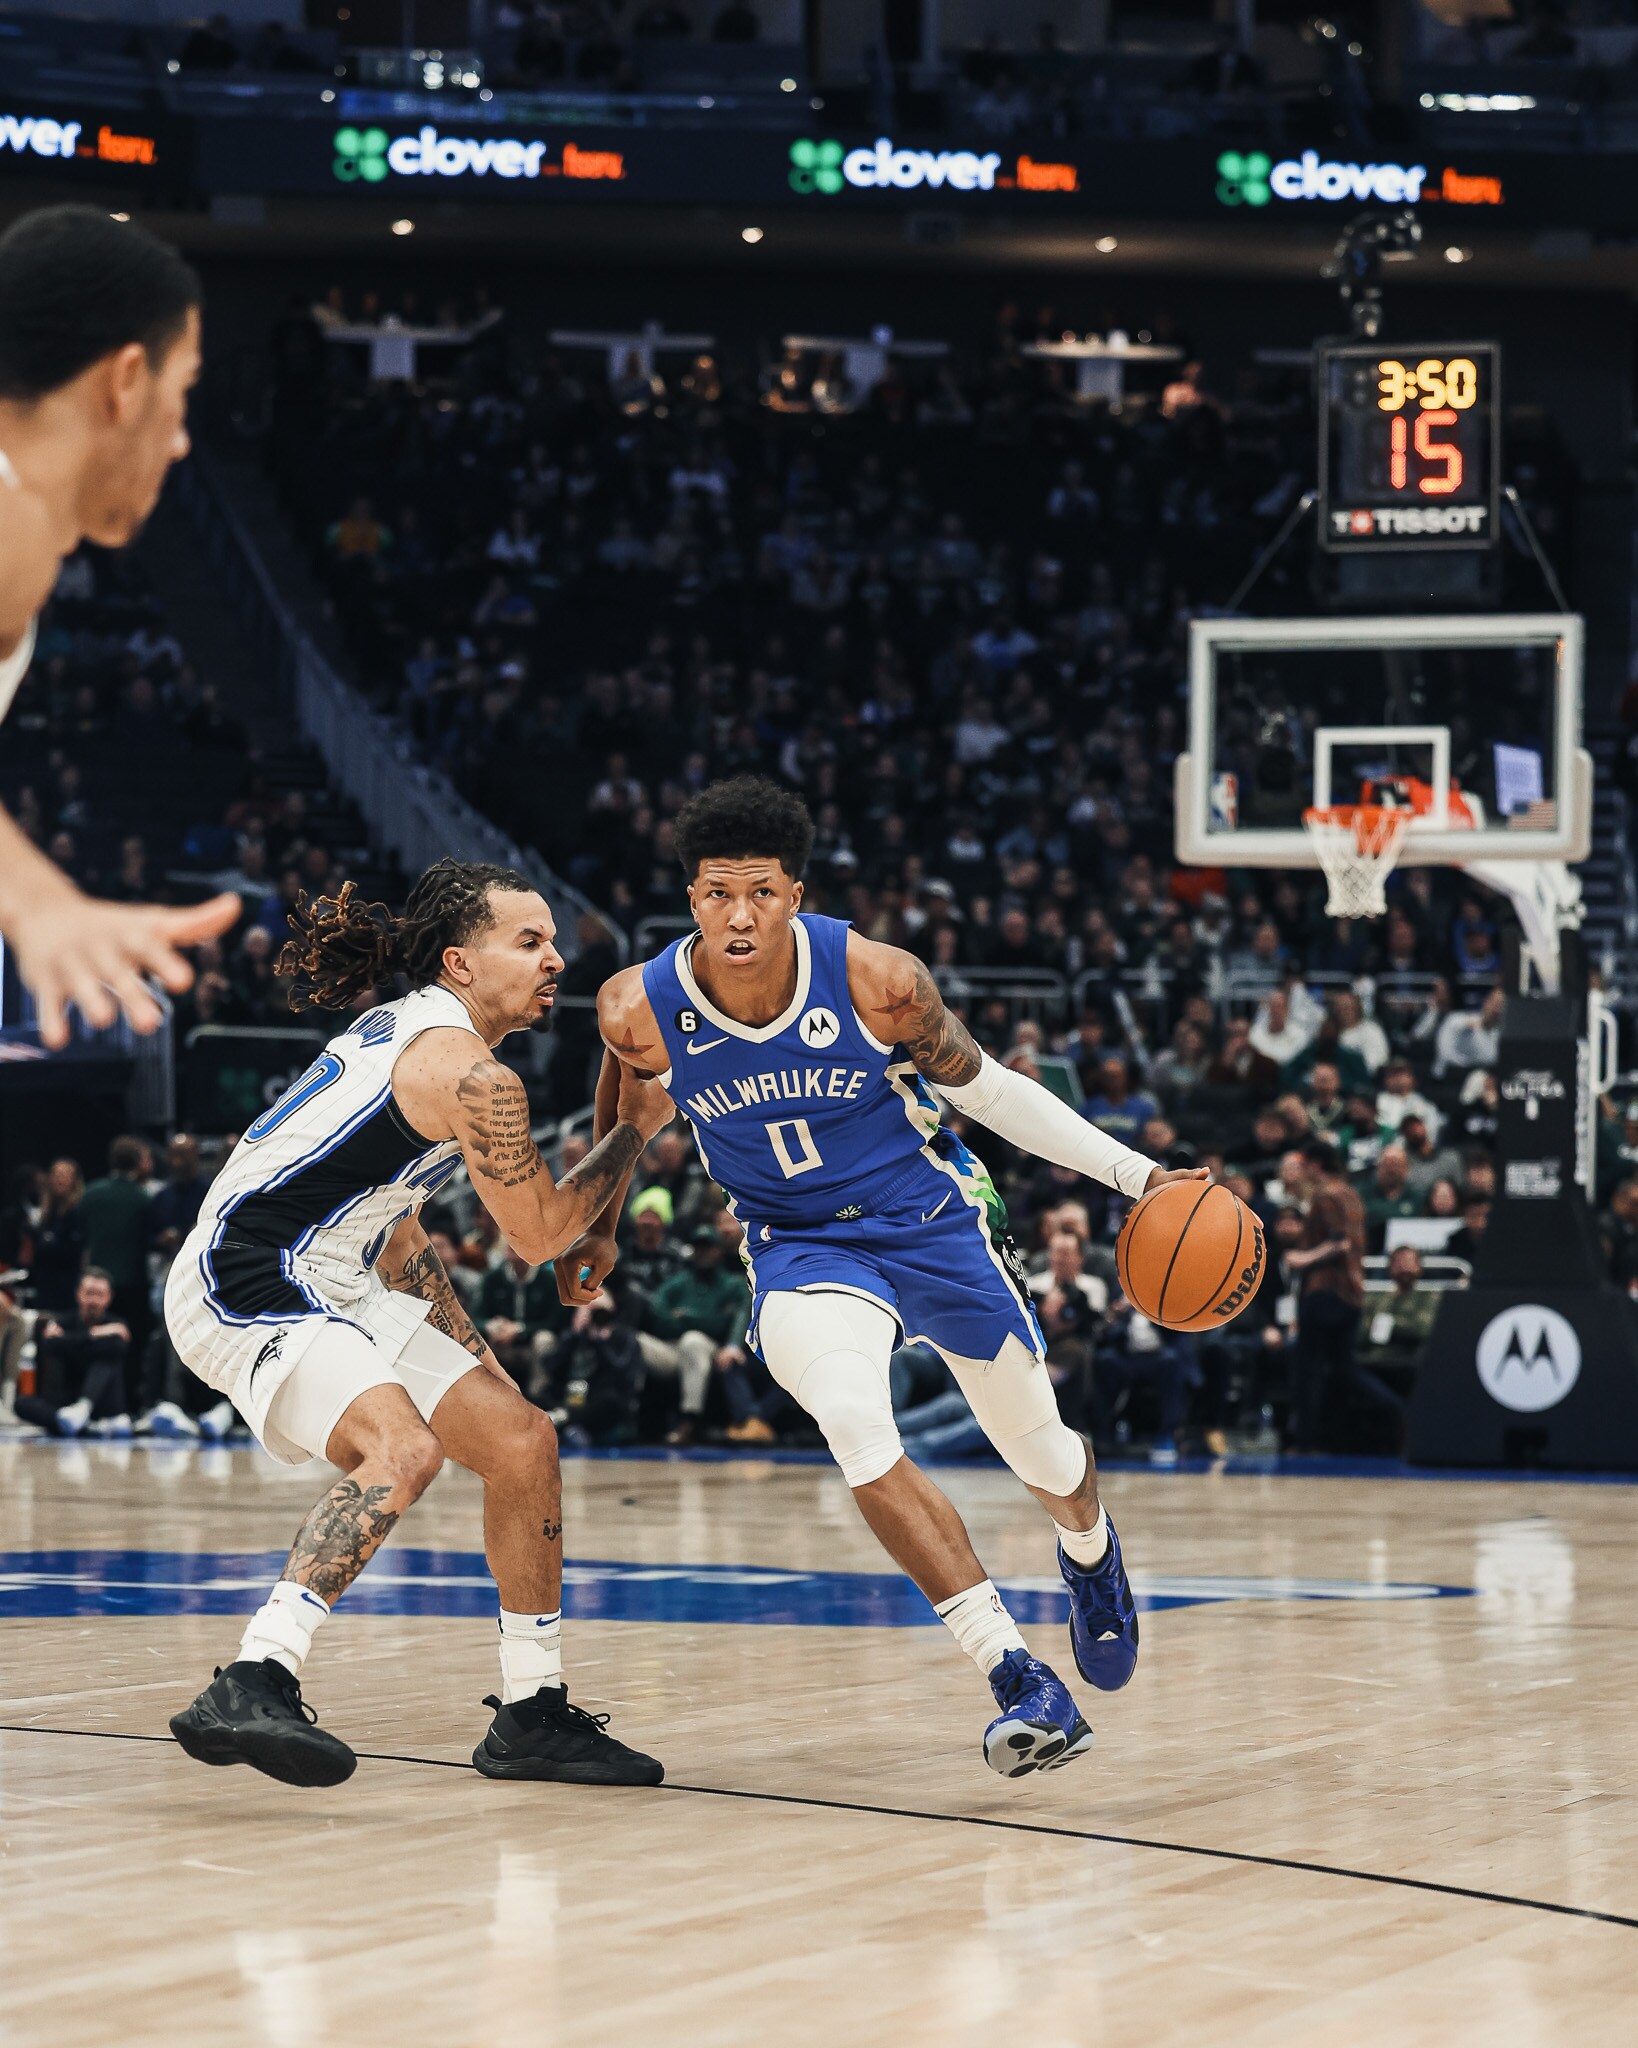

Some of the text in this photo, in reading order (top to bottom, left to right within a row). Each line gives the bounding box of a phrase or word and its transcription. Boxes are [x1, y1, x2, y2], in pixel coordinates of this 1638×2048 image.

[0, 114, 81, 158] ver
[388, 125, 546, 178] clover
[843, 137, 1001, 190] clover
[1270, 149, 1427, 203] clover
[1378, 359, 1476, 411] 3:50
[1391, 410, 1462, 494] 15
[1374, 506, 1487, 534] TISSOT
[680, 1011, 697, 1032] 6
[686, 1068, 868, 1124] MILWAUKEE
[765, 1118, 824, 1179] 0
[1212, 1225, 1265, 1317] Wilson
